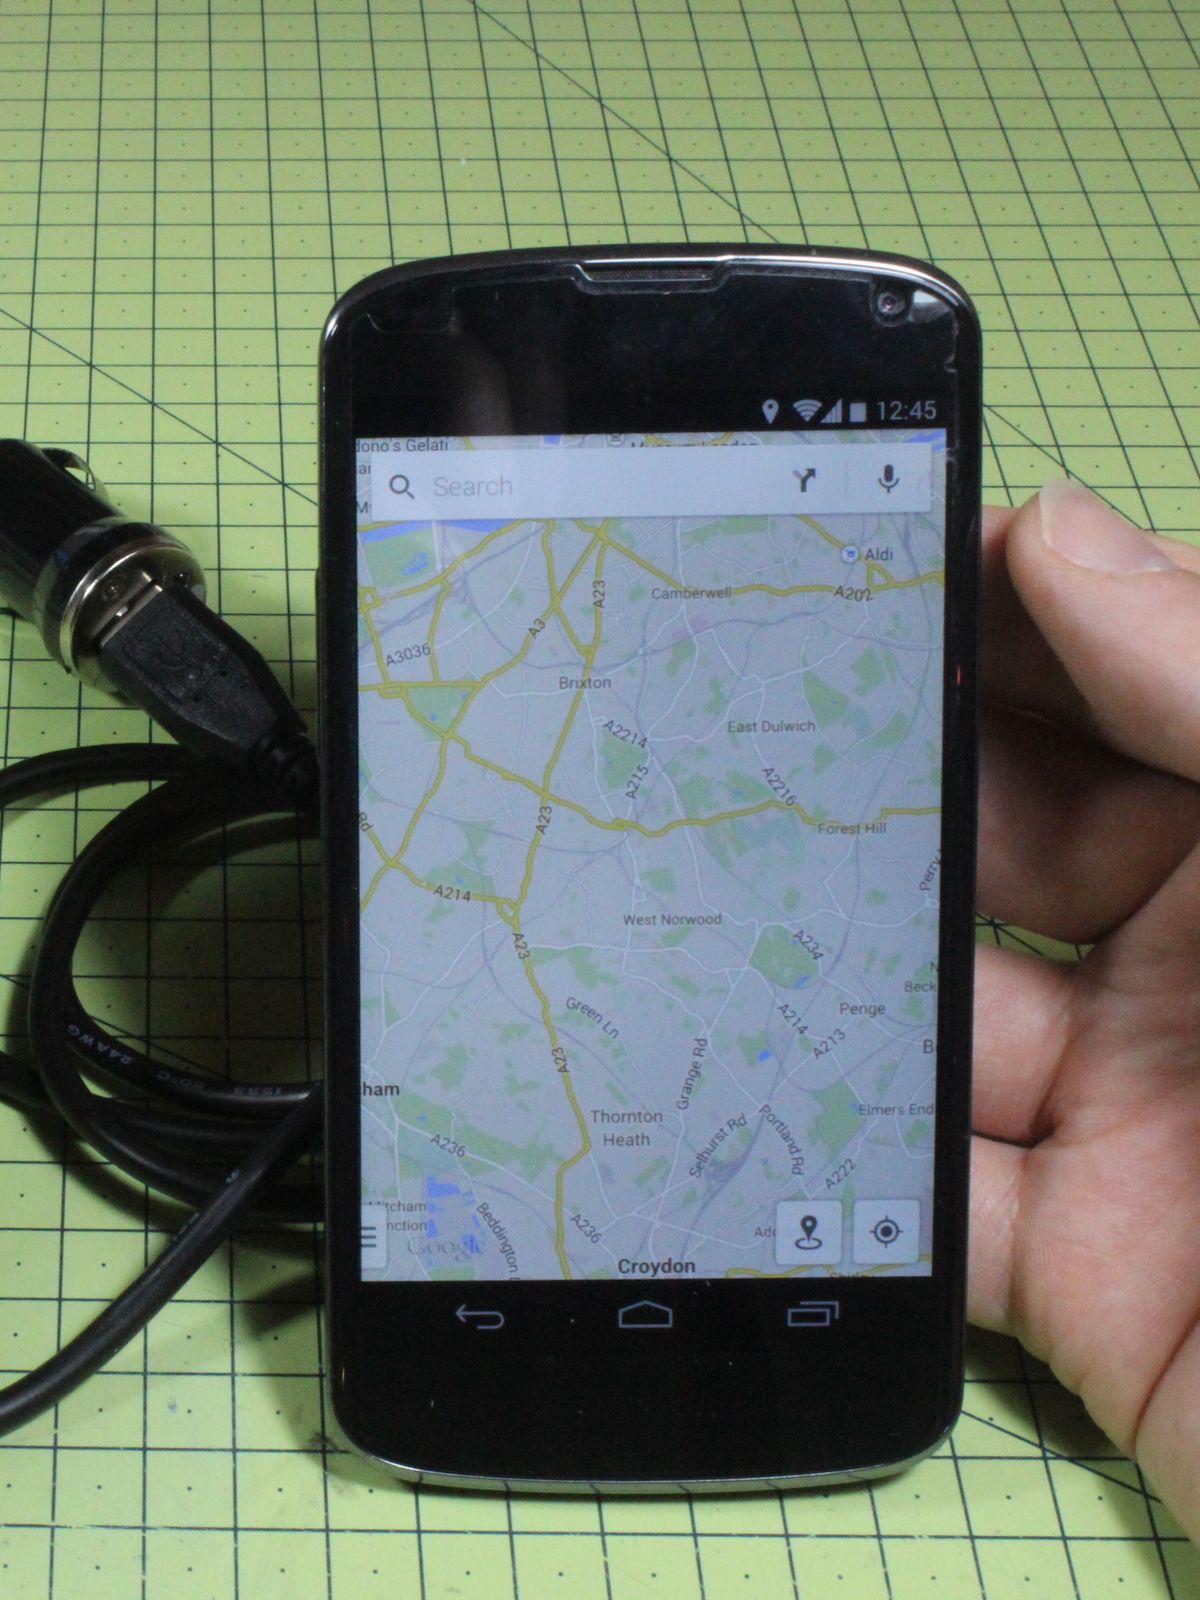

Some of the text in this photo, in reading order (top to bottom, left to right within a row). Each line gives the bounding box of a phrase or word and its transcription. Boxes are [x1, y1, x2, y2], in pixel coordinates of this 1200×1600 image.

[878, 400, 937, 421] 12:45
[433, 475, 513, 498] Search
[864, 548, 894, 561] Aldi
[593, 579, 606, 609] A23
[652, 587, 733, 600] Camberwell
[834, 584, 874, 603] A202
[528, 618, 547, 640] A3
[386, 642, 432, 667] A3036
[558, 676, 612, 690] Brixton
[602, 720, 648, 750] A2214
[728, 720, 816, 733] East Dulwich
[625, 764, 649, 800] A215
[761, 766, 796, 807] A2216
[536, 805, 553, 835] A23
[817, 822, 887, 835] Forest Hill
[433, 885, 472, 903] A214
[623, 913, 722, 926] West Norwood
[512, 932, 530, 960] A23
[793, 929, 824, 961] A234
[565, 996, 620, 1040] Green Ln
[777, 1003, 809, 1036] A214
[840, 1003, 886, 1018] Penge
[813, 1028, 846, 1060] A213
[552, 1047, 570, 1074] A23
[676, 1038, 708, 1111] Grange Rd
[591, 1109, 664, 1124] Thornton
[859, 1103, 934, 1116] Elmers End
[430, 1133, 466, 1158] A236
[603, 1133, 651, 1147] Heath
[689, 1113, 748, 1179] Selhurst Rd
[758, 1104, 805, 1176] Portland Rd
[824, 1158, 857, 1190] A222
[477, 1202, 519, 1273] Beddington
[570, 1213, 602, 1245] A236
[618, 1258, 696, 1277] Croydon
